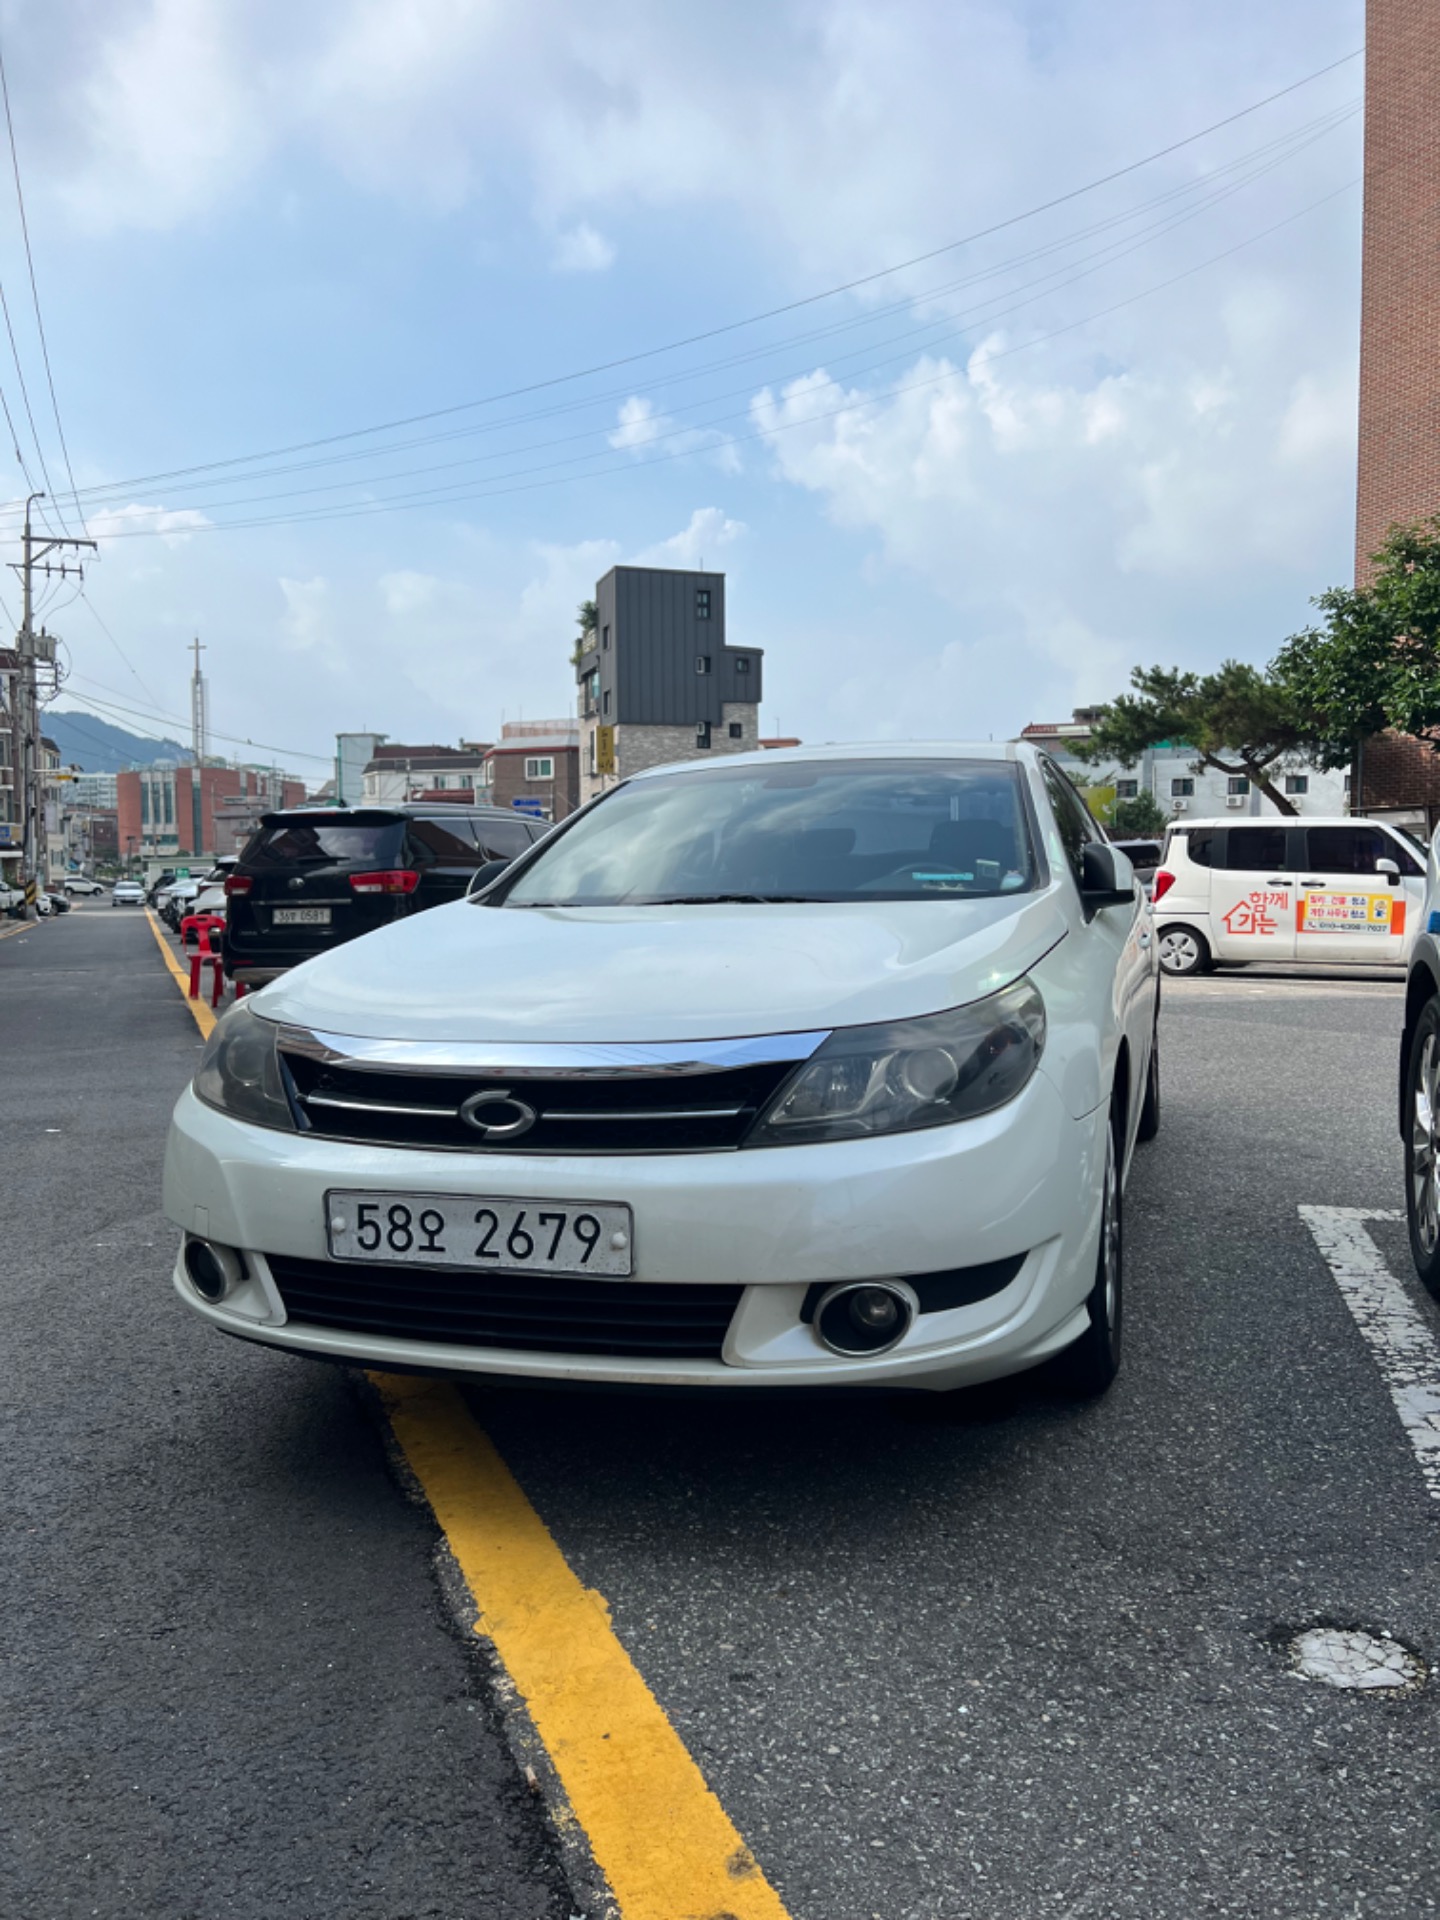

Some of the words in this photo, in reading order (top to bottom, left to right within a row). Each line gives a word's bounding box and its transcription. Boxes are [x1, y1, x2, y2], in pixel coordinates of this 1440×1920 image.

[1249, 891, 1288, 913] 함께
[1238, 912, 1278, 934] 가는
[357, 1203, 446, 1253] 58오
[473, 1208, 602, 1264] 2679
